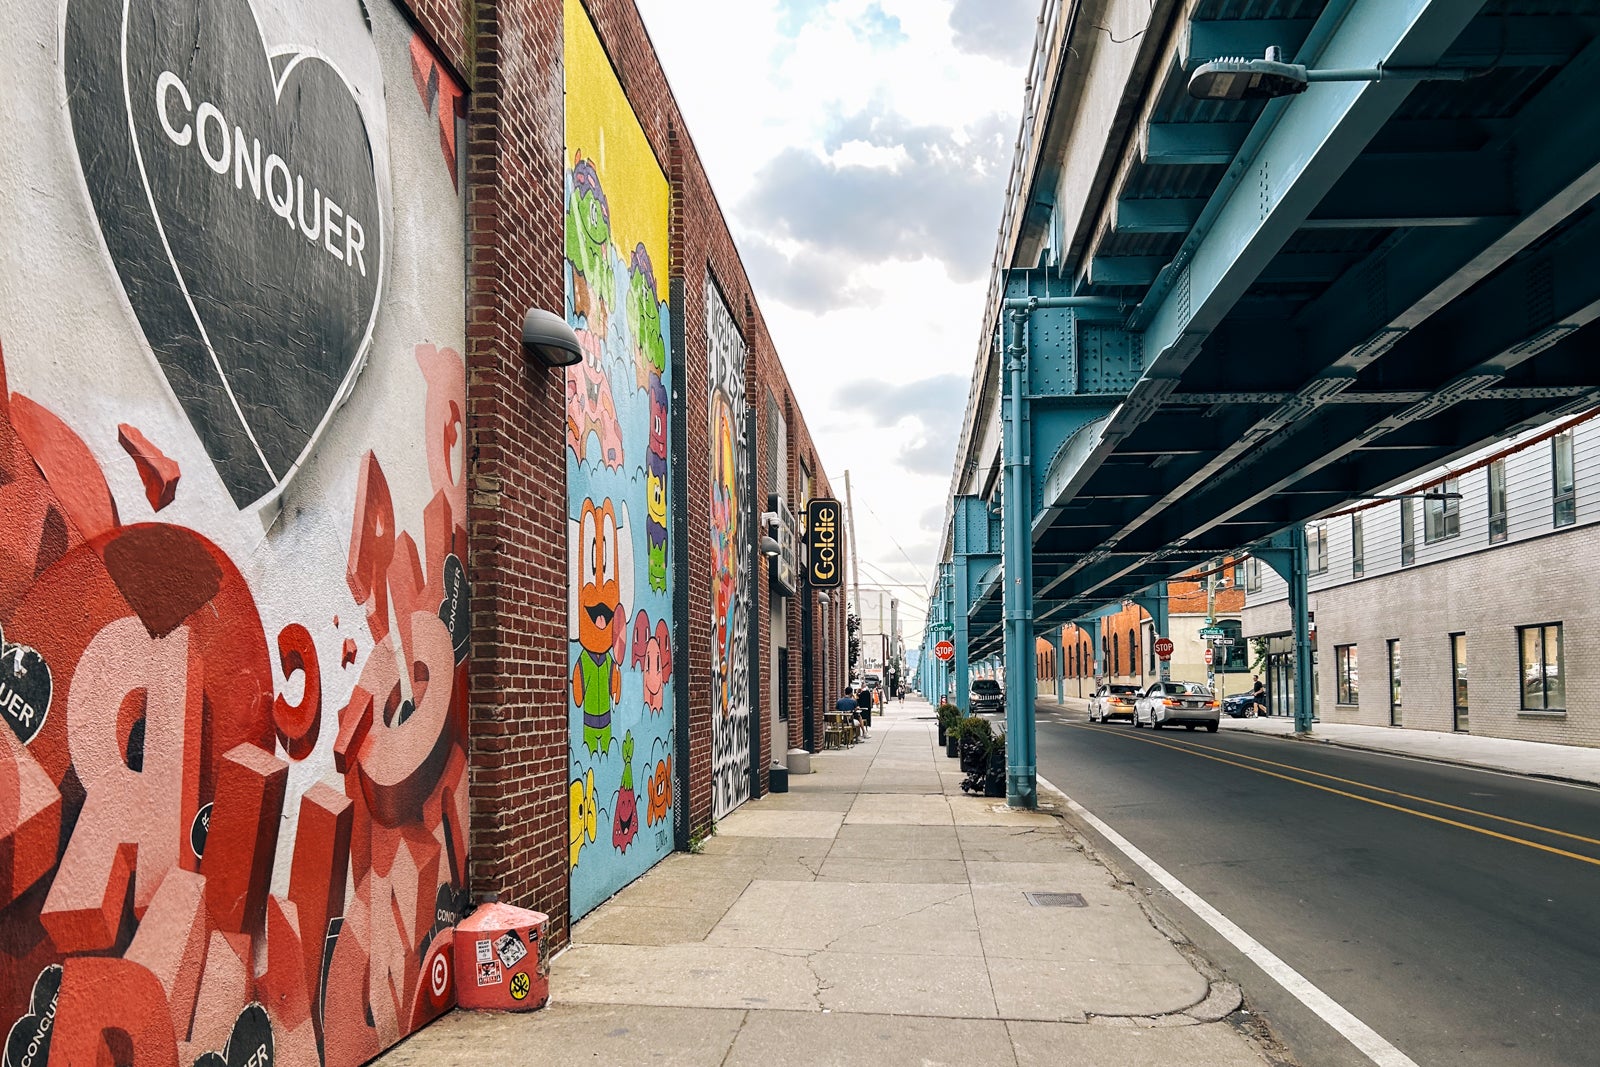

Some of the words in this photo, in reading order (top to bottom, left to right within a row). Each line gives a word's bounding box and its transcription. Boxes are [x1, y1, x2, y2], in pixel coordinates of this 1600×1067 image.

[155, 70, 366, 278] CONQUER
[814, 508, 835, 580] Goldie
[449, 567, 461, 641] ONQUER
[935, 646, 953, 656] STOP
[1155, 643, 1173, 652] STOP
